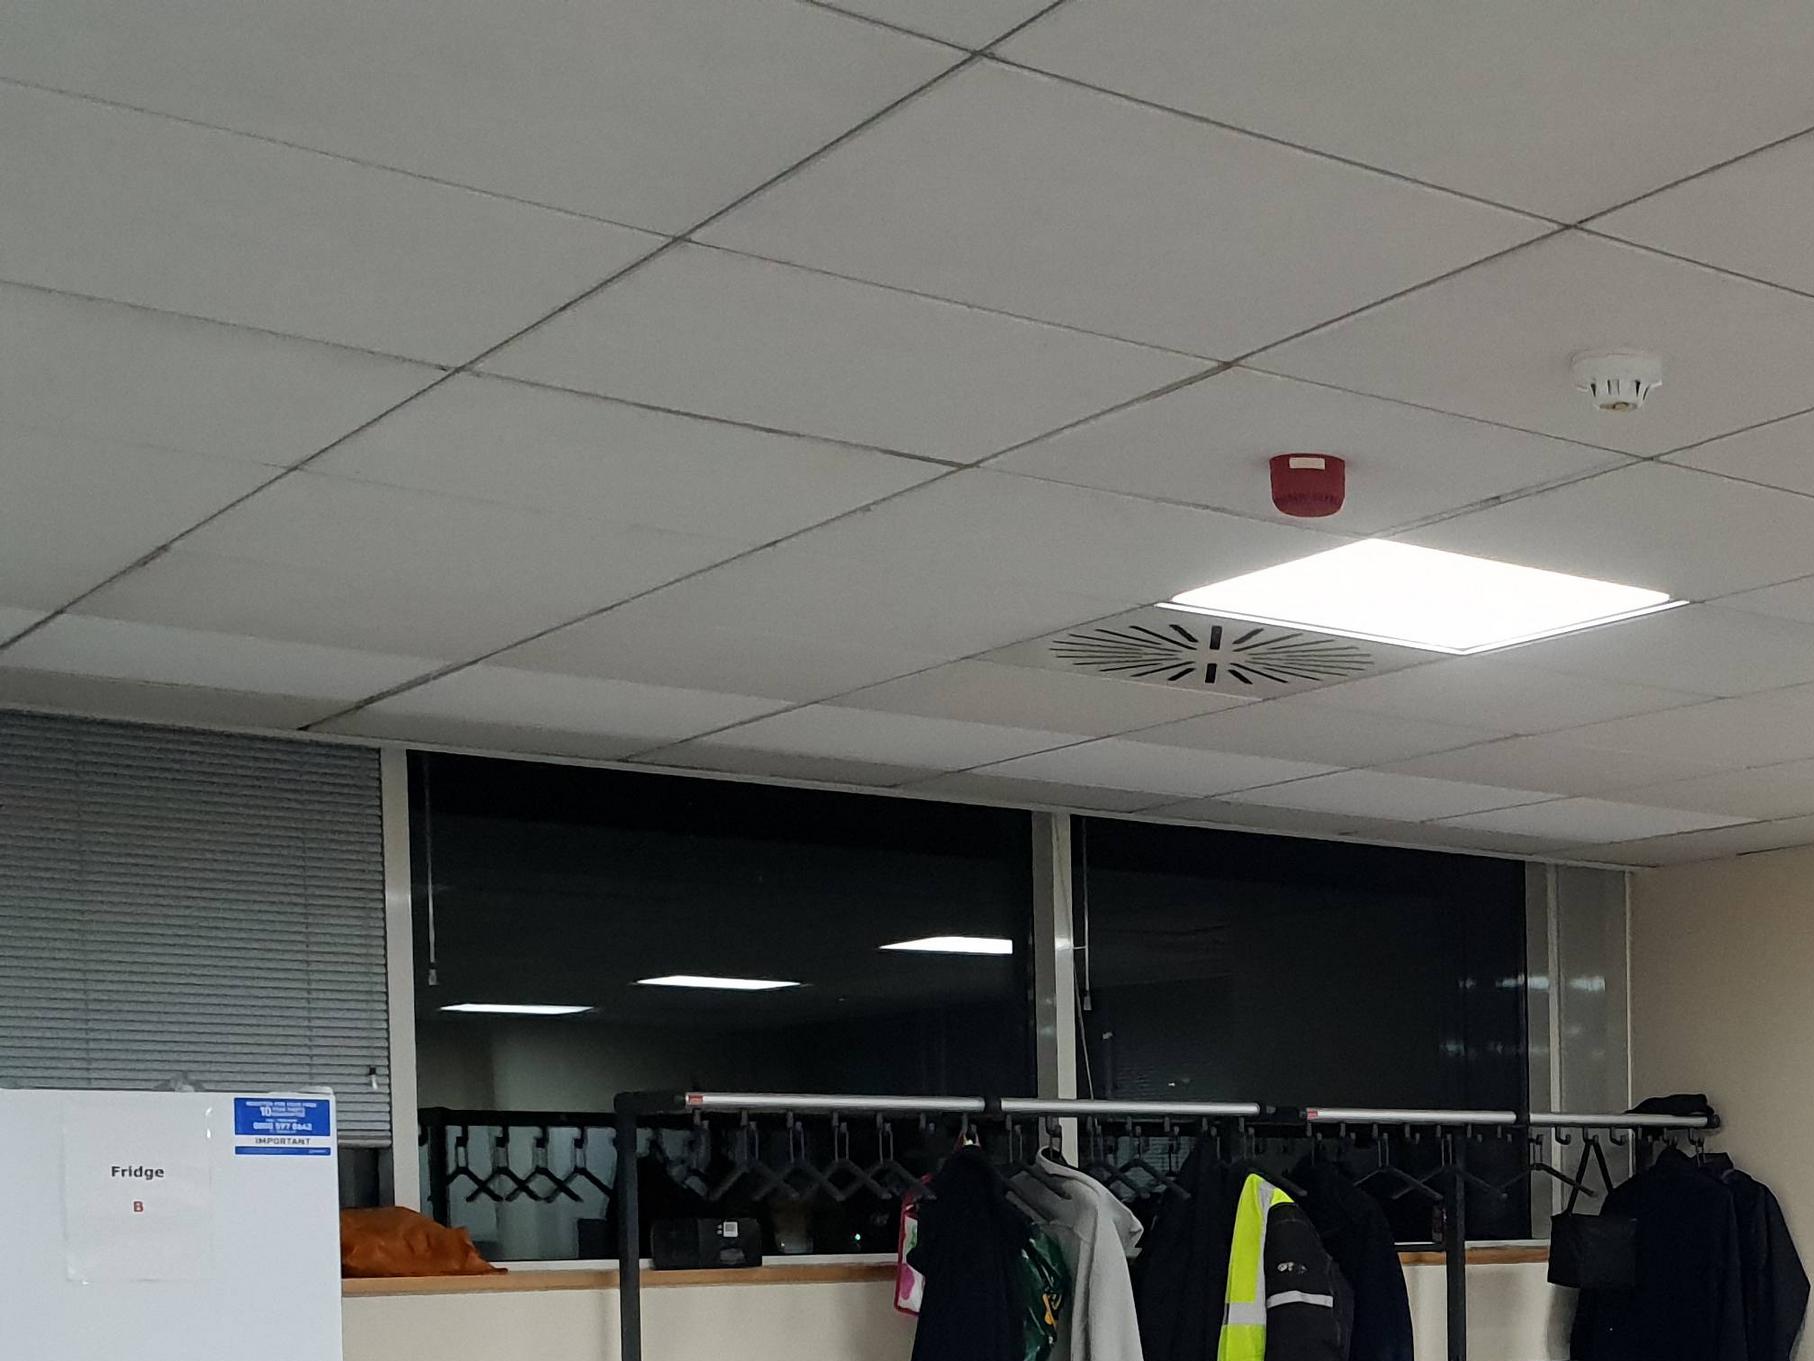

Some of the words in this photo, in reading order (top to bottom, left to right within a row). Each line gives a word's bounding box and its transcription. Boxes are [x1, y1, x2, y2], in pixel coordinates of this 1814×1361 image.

[255, 1137, 311, 1145] IMPORTANT
[111, 1165, 164, 1180] Fridge
[133, 1201, 144, 1213] B
